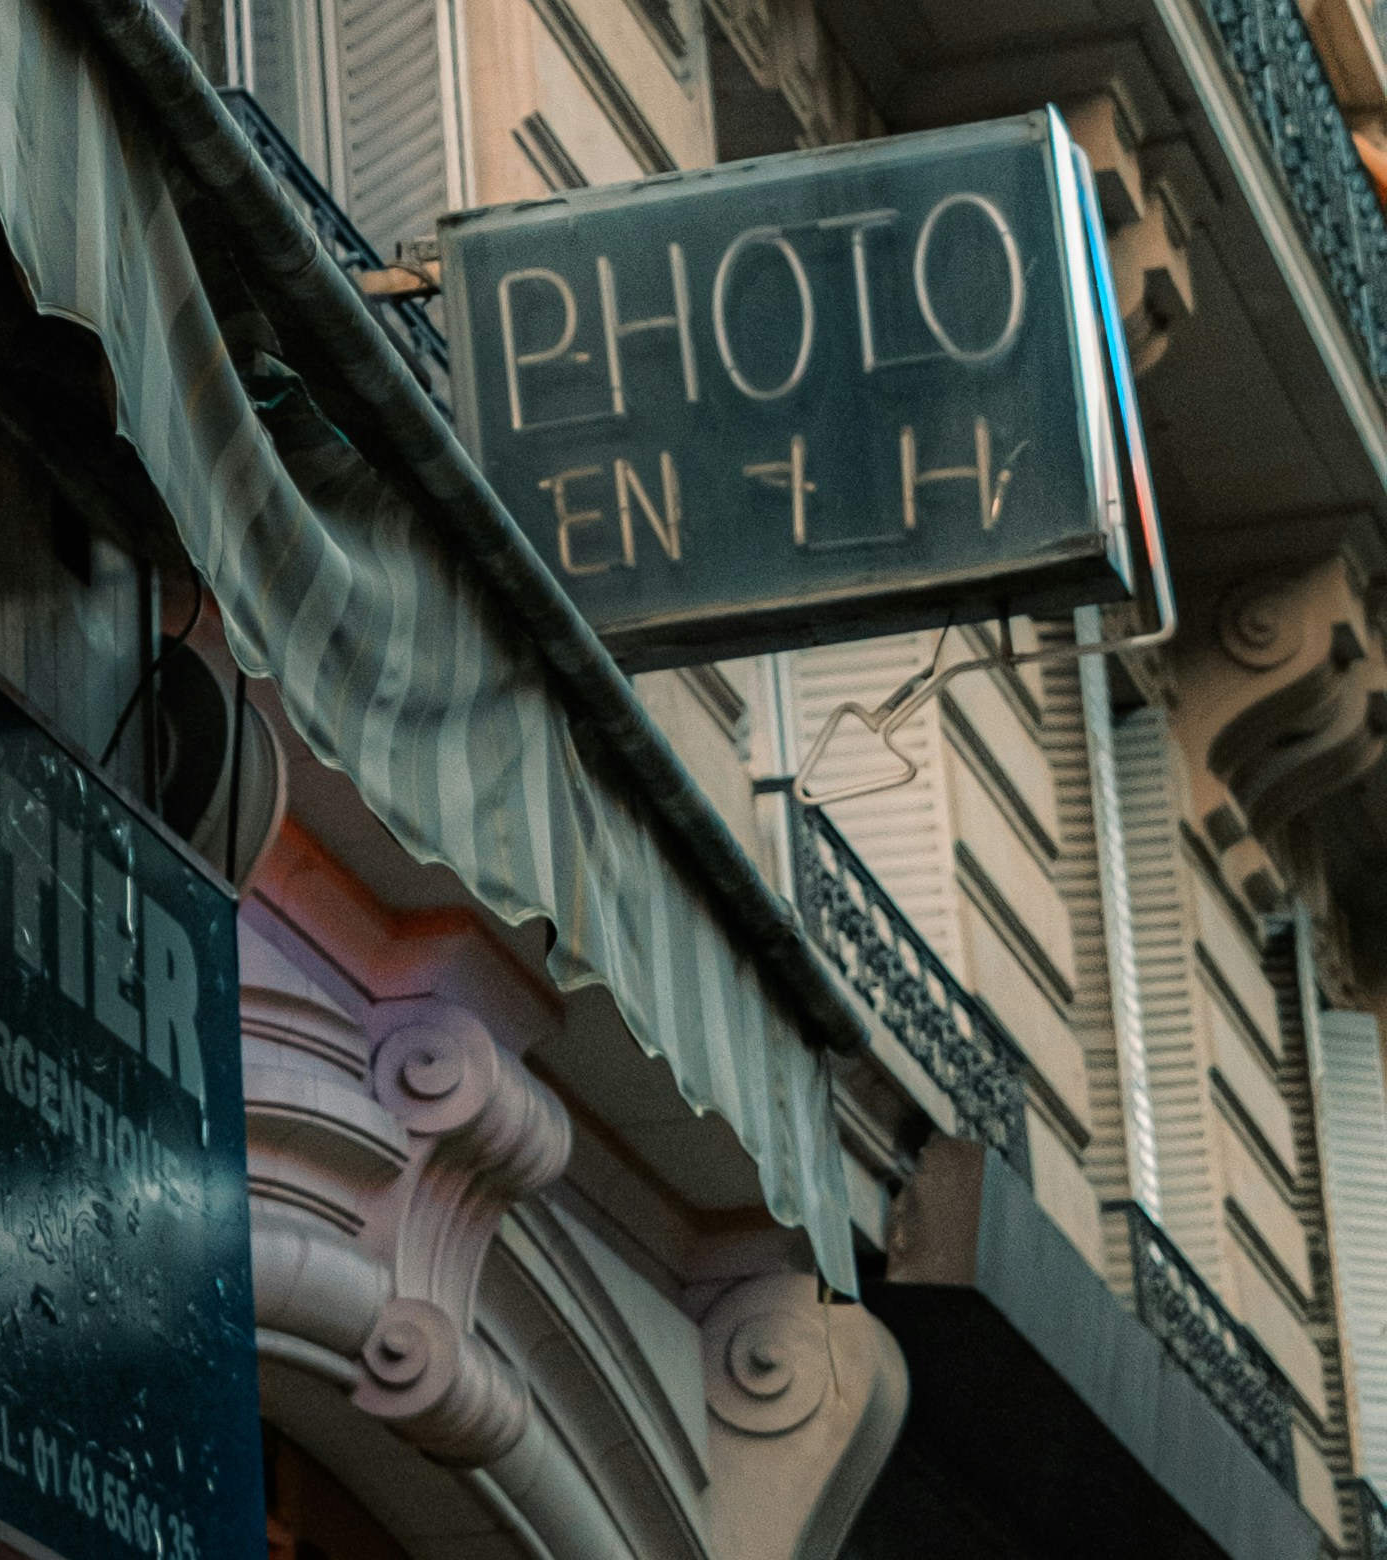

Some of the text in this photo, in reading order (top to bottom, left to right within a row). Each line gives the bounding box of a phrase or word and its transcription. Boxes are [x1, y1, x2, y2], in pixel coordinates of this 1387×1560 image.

[499, 192, 1023, 430] PHOTO
[539, 451, 681, 577] EN
[32, 1425, 62, 1499] 01
[67, 1444, 99, 1522] 43
[102, 1478, 133, 1549] 55
